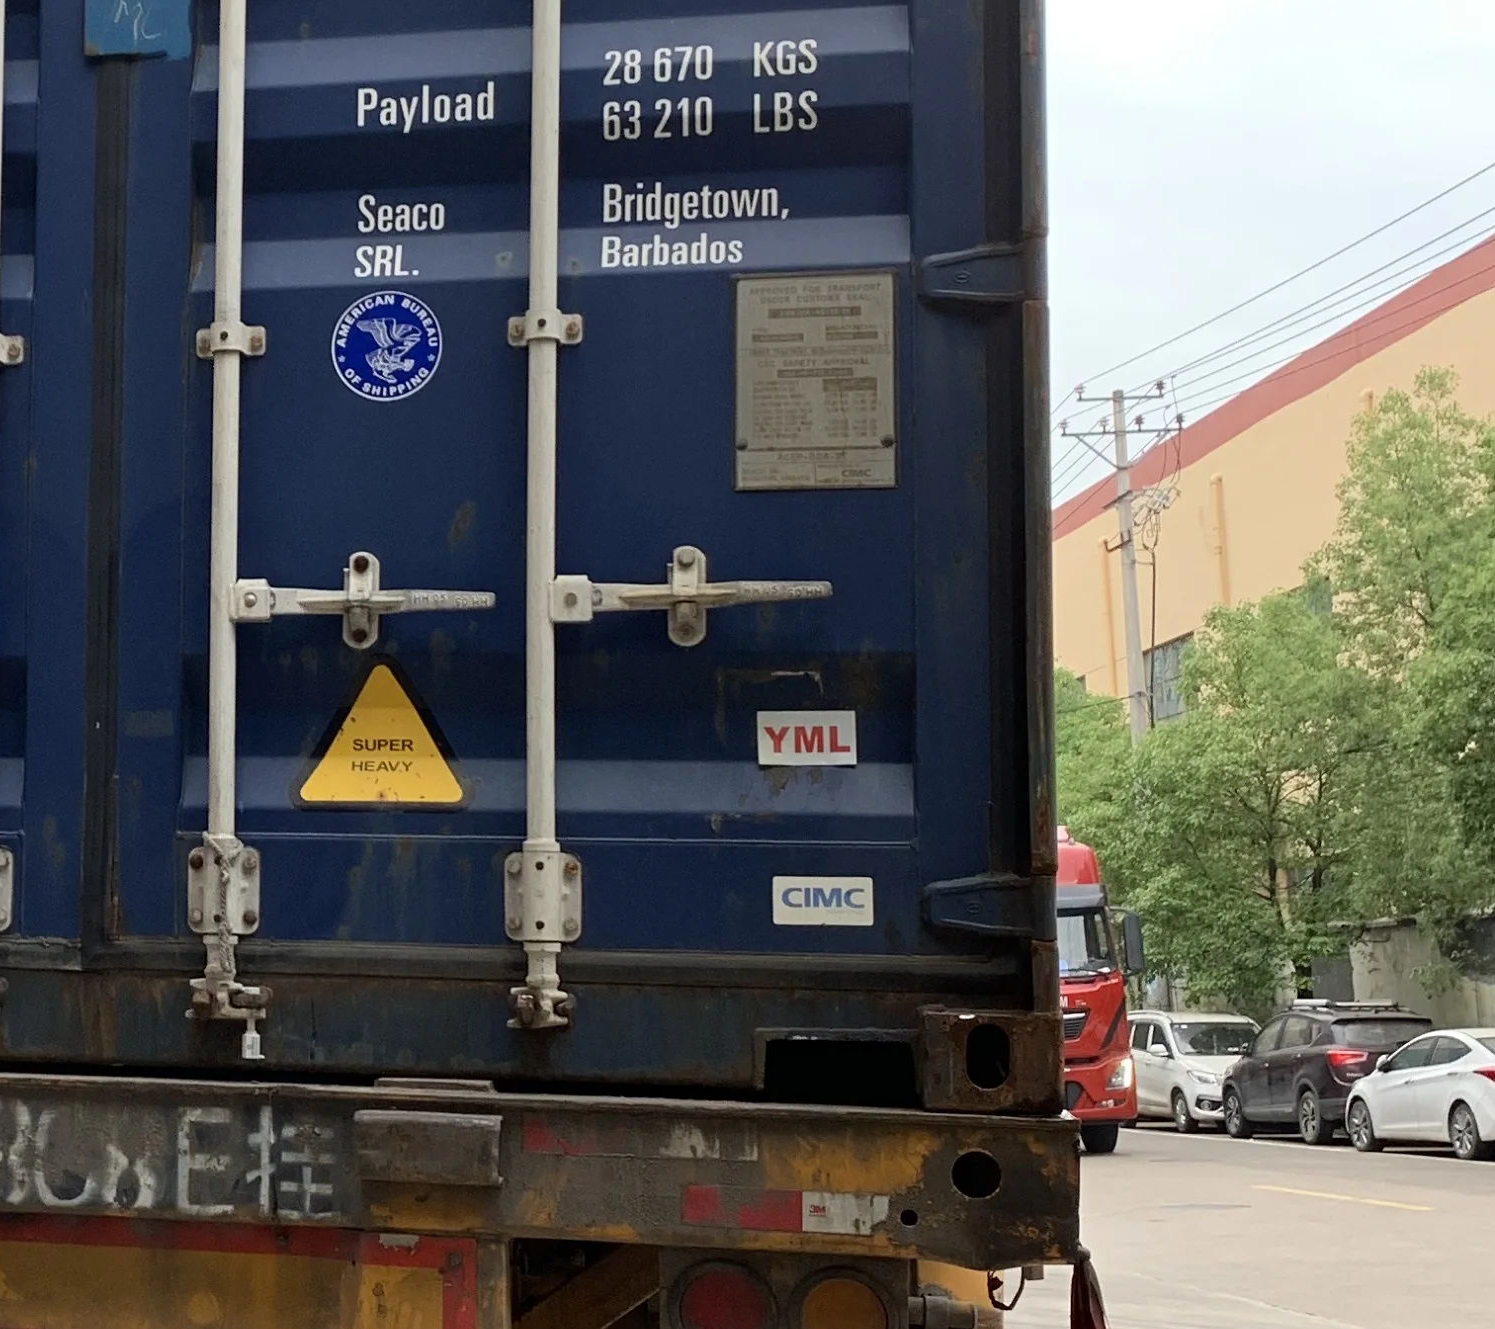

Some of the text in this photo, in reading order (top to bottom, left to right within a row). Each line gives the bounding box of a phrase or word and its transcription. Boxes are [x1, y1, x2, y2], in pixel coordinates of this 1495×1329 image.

[603, 38, 818, 86] 28 670 KGS
[357, 81, 495, 134] Payload
[603, 89, 818, 141] 63 210 LBS
[357, 194, 445, 234] Seaco
[603, 181, 790, 231] Bridgetown,
[354, 243, 420, 278] SRL.
[601, 233, 743, 269] Barbados
[337, 295, 438, 348] AMERICAN BUREAU
[344, 367, 429, 397] OF SHIPPING
[352, 738, 414, 752] SUPER
[763, 725, 851, 754] YML
[351, 760, 413, 772] HEAVY
[781, 887, 865, 909] CIMC
